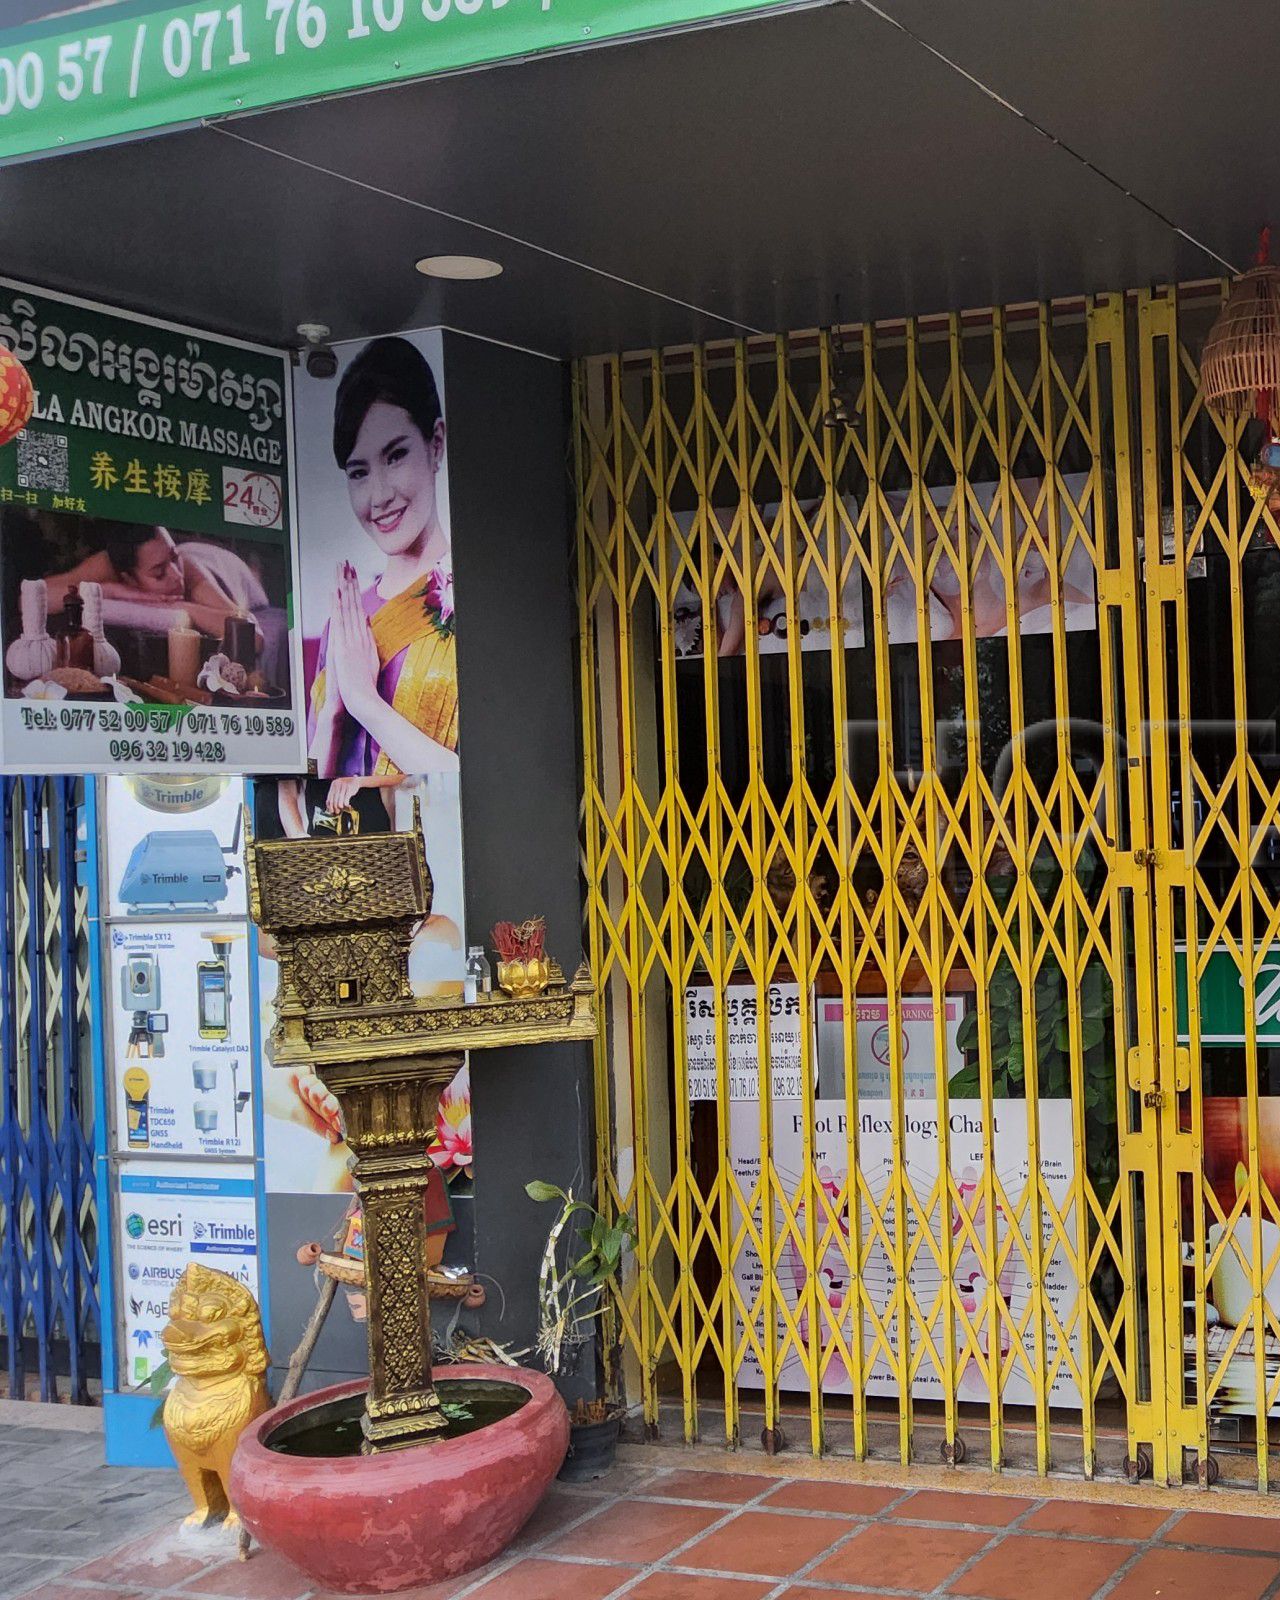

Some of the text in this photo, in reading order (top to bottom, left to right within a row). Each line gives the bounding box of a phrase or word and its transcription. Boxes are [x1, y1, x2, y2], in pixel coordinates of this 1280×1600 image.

[57, 35, 112, 101] 57
[129, 24, 146, 98] /
[162, 4, 250, 78] 071
[265, 0, 326, 55] 76
[32, 390, 282, 465] LA ANGKOR MASSAGE
[90, 451, 212, 506] 养生按摩
[223, 481, 255, 510] 24
[21, 707, 54, 729] Tel:
[60, 708, 94, 730] 077
[99, 709, 122, 731] 52
[124, 710, 147, 731] 00
[149, 711, 171, 732] 57
[187, 712, 217, 734] 071
[221, 714, 241, 735] 76
[245, 714, 264, 735] 10
[266, 715, 295, 736] 589
[109, 739, 226, 762] 096 32 19 428
[154, 785, 204, 804] Trimble
[152, 873, 189, 884] Trimble
[128, 933, 171, 941] Trimble SX12
[902, 1009, 933, 1019] ARNING
[150, 1106, 175, 1115] Trimble
[793, 1114, 832, 1134] Fot
[949, 1114, 1000, 1134] Chat
[150, 1141, 183, 1150] Handheld
[199, 1137, 224, 1146] Trimble
[148, 1213, 182, 1237] esri
[208, 1223, 255, 1241] Trimble
[142, 1266, 182, 1280] AIRBUS
